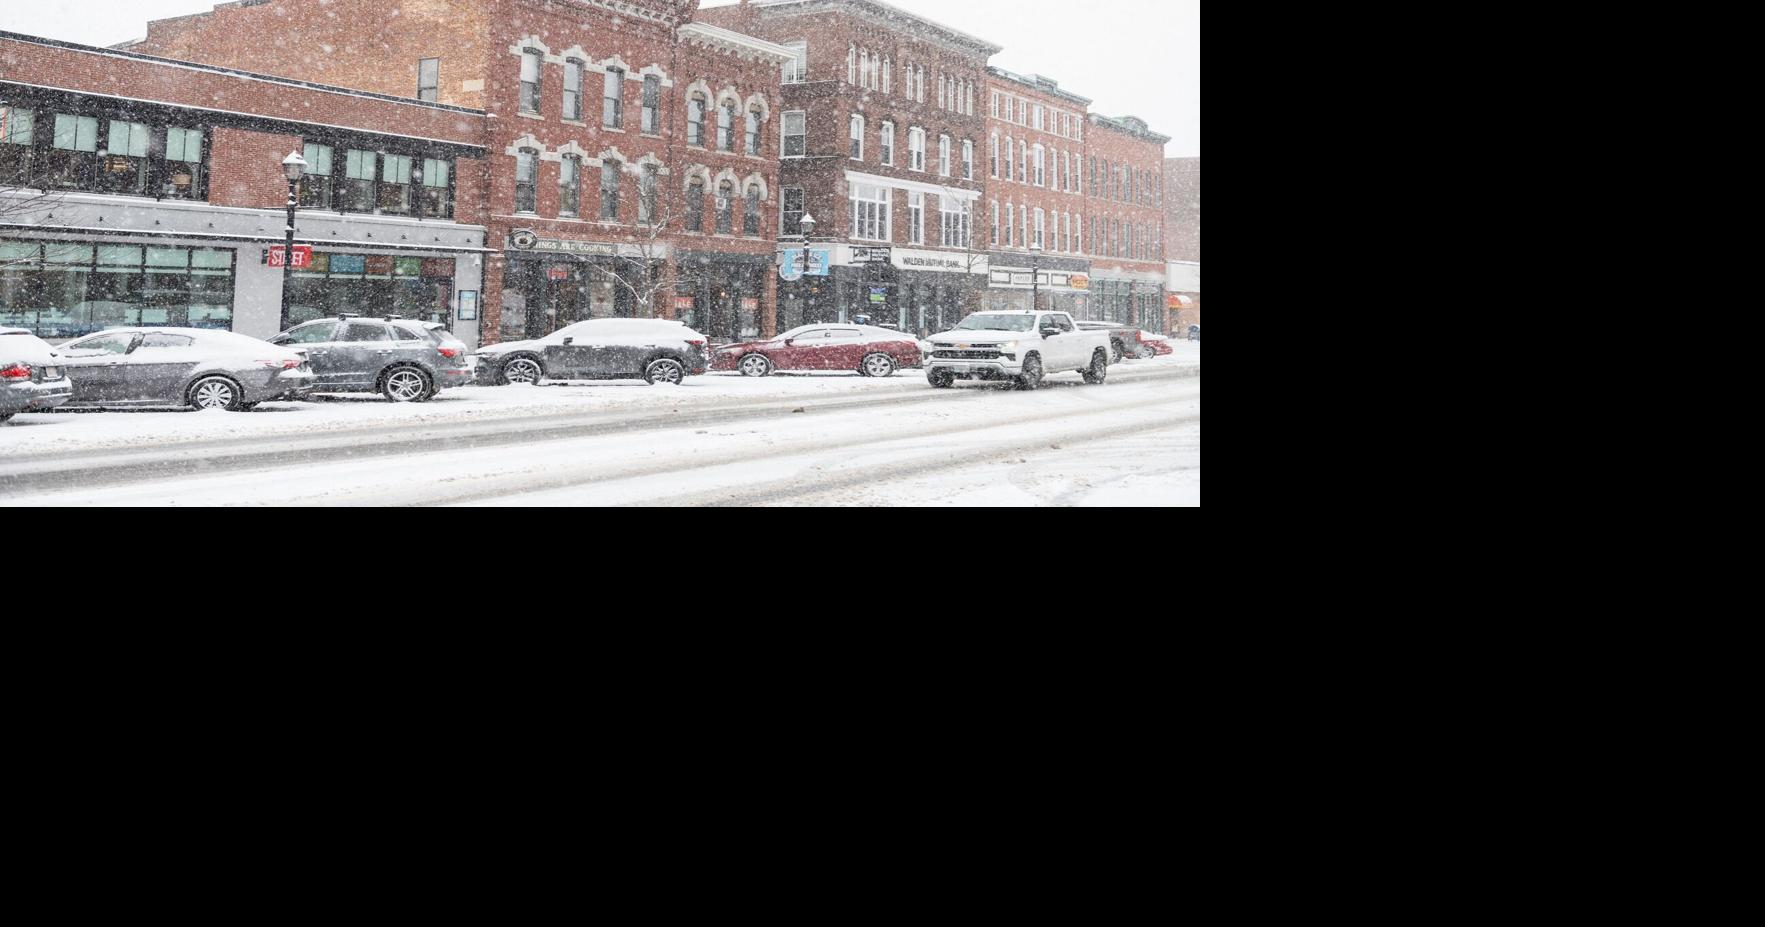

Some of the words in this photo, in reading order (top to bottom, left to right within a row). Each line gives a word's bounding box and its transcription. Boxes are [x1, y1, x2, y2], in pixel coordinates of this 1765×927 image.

[560, 243, 576, 251] ARE
[579, 244, 612, 253] COOKING
[902, 257, 924, 267] WALDEN
